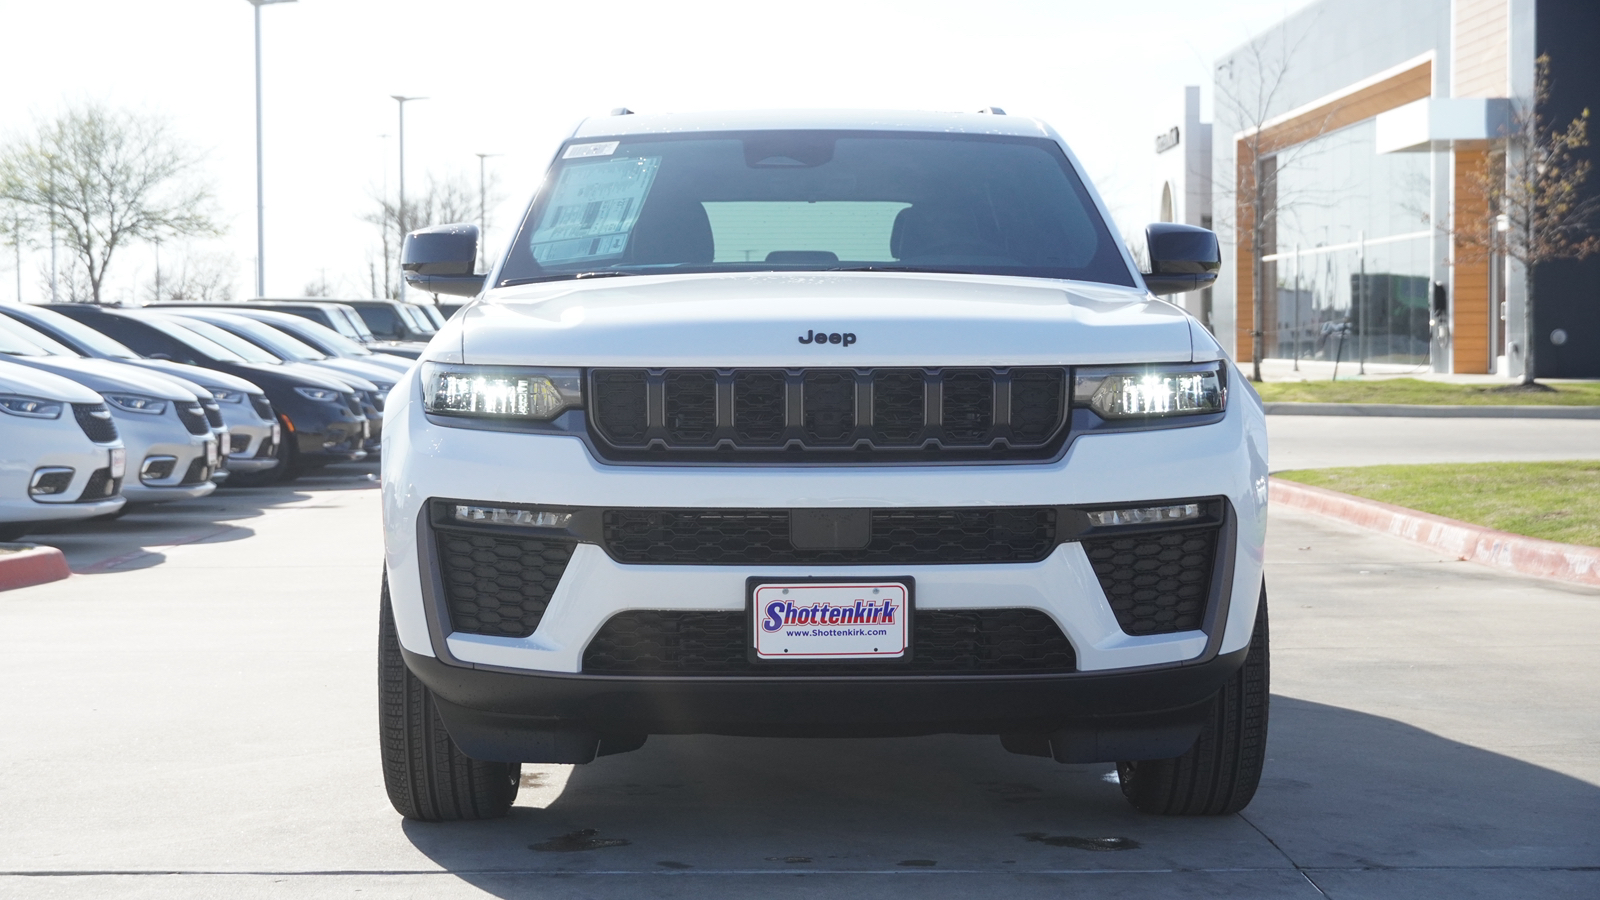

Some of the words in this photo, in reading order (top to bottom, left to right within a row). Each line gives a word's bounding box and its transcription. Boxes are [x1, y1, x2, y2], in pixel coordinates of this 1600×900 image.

[798, 329, 857, 347] Jeep
[763, 600, 898, 632] Shottenkirk
[786, 628, 887, 637] www.Shottenkirk.com
